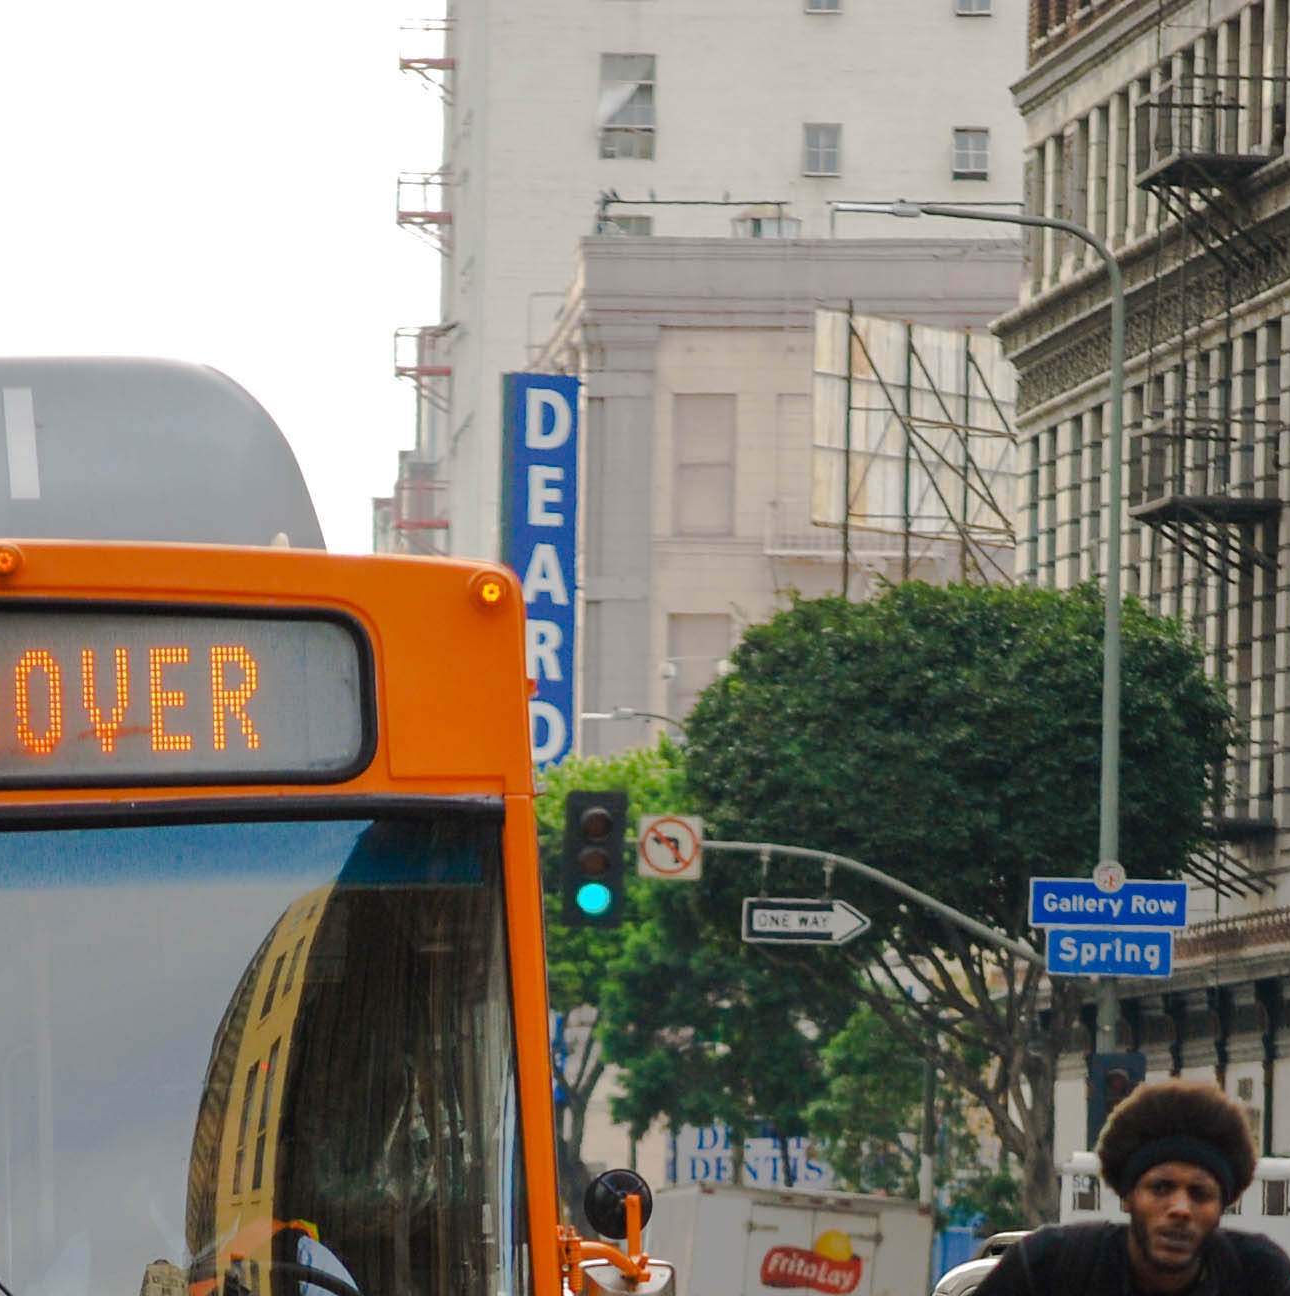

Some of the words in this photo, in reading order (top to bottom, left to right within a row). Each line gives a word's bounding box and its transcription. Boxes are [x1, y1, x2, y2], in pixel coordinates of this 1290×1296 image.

[1042, 892, 1123, 918] Gallery
[1130, 894, 1178, 916] Row
[759, 911, 792, 929] ONE
[796, 913, 830, 930] WAY
[1058, 935, 1162, 970] Spring
[689, 1156, 824, 1183] DENTIS
